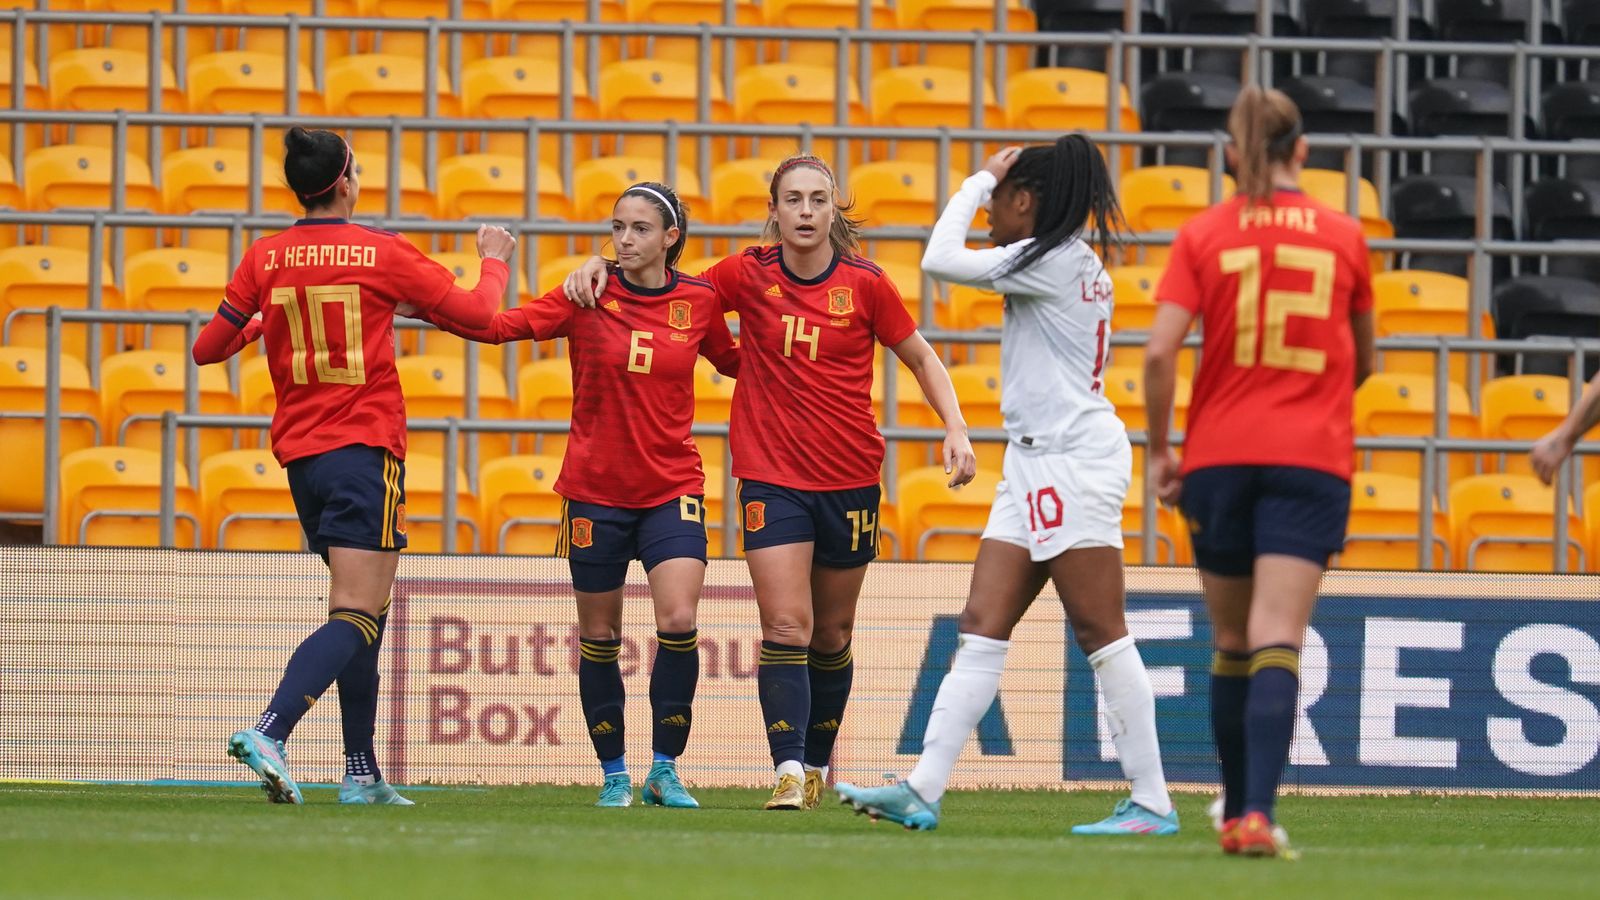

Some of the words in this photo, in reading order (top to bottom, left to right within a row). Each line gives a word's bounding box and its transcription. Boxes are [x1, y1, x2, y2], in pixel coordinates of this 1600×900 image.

[264, 249, 279, 271] J.
[285, 245, 377, 269] HERMOSO
[1219, 243, 1336, 374] 12
[271, 284, 366, 385] 10
[627, 330, 654, 374] 6
[781, 314, 821, 361] 14
[846, 510, 876, 552] 14
[1026, 486, 1064, 532] 10
[429, 684, 562, 747] Box
